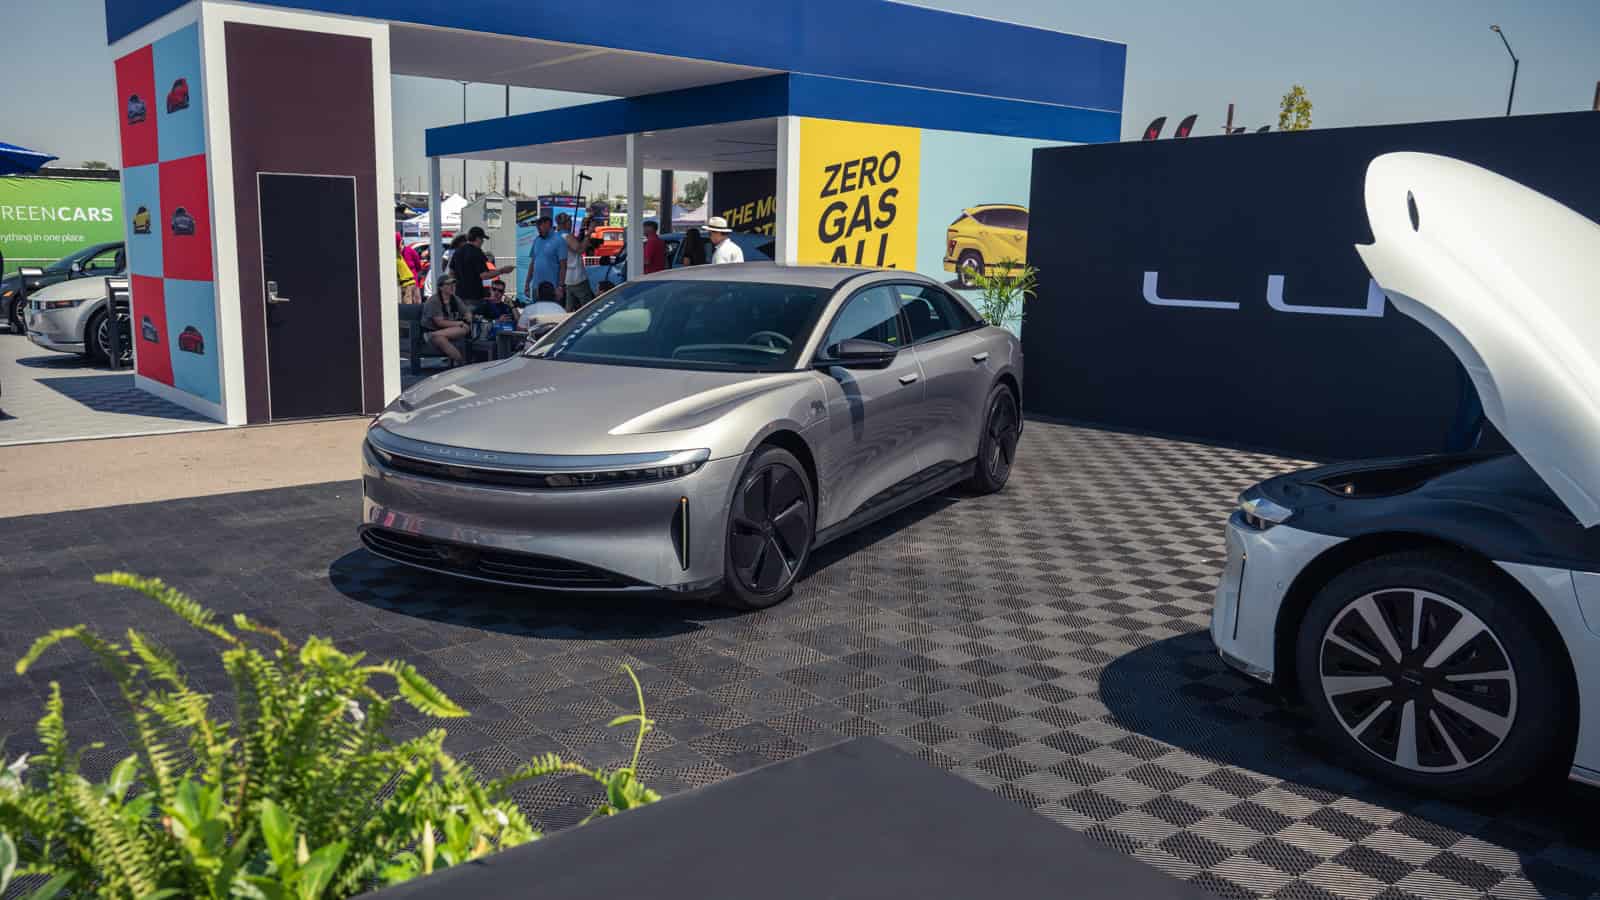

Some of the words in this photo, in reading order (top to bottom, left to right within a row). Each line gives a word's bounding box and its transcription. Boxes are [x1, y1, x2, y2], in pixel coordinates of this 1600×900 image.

[820, 150, 901, 198] ZERO
[722, 202, 754, 227] THE
[818, 187, 899, 243] GAS
[33, 231, 42, 241] in
[43, 233, 60, 242] one
